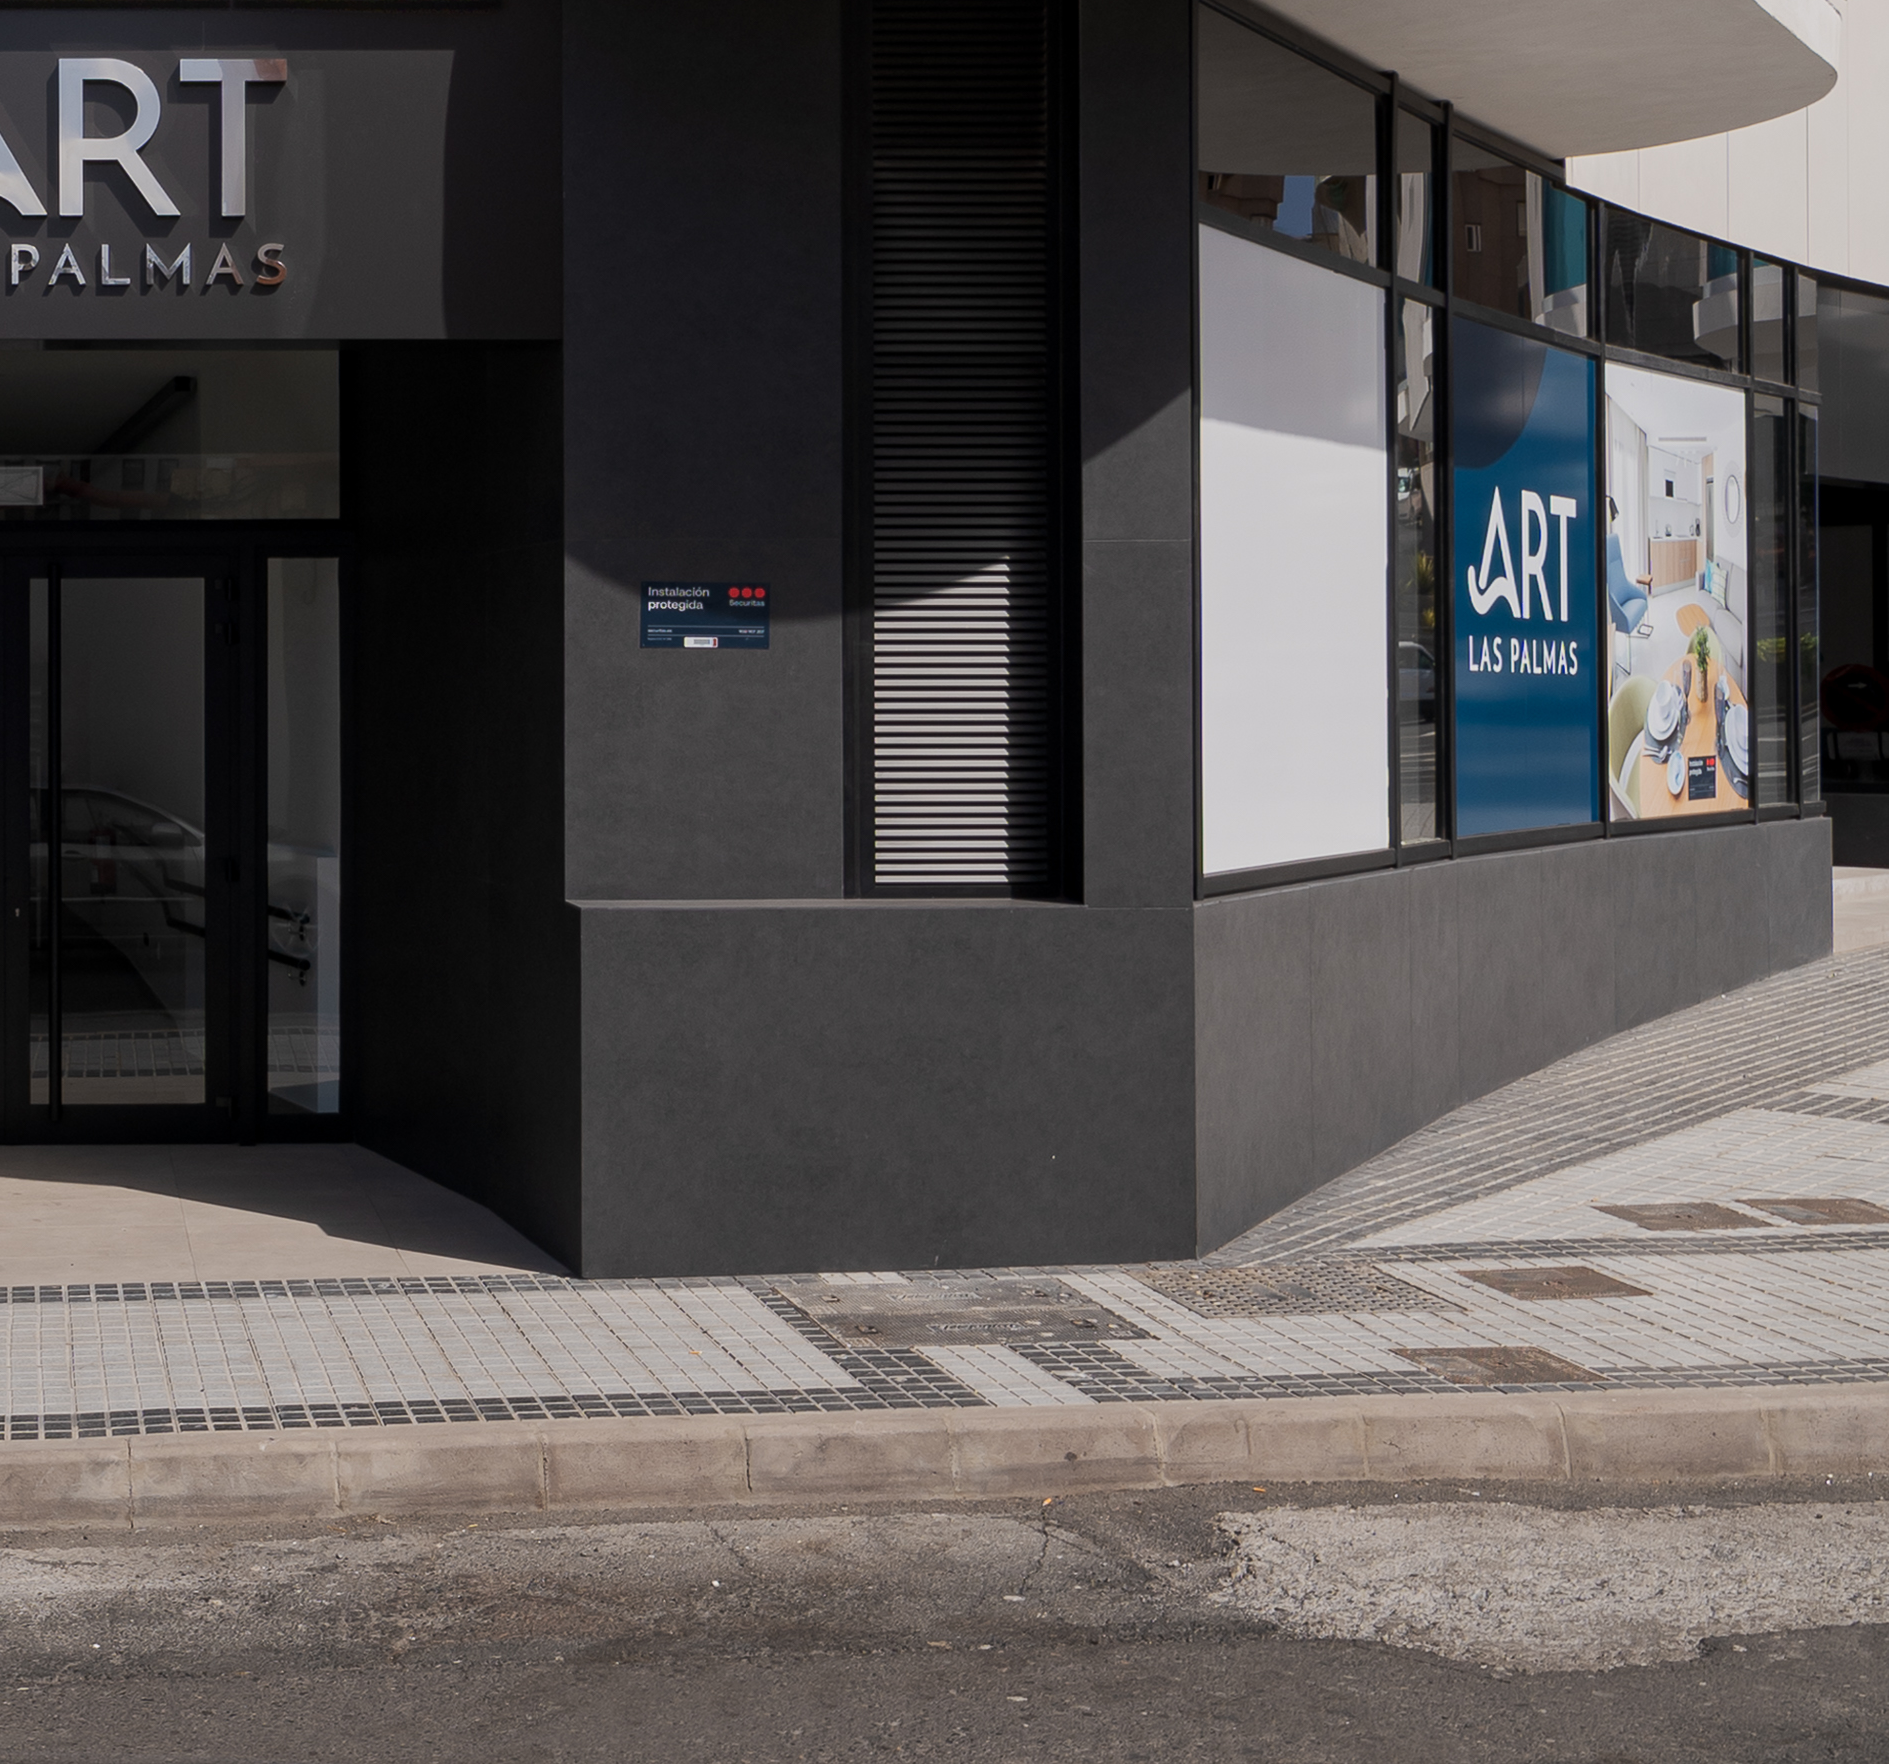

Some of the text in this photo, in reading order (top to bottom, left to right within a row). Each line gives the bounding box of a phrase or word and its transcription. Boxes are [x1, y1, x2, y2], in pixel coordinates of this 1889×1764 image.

[11, 242, 288, 286] PALMAS
[1467, 485, 1577, 622] ART
[647, 585, 710, 598] Instalación
[728, 599, 766, 607] Securitas
[647, 599, 704, 612] protegida
[1468, 634, 1579, 676] LAS PALMAS
